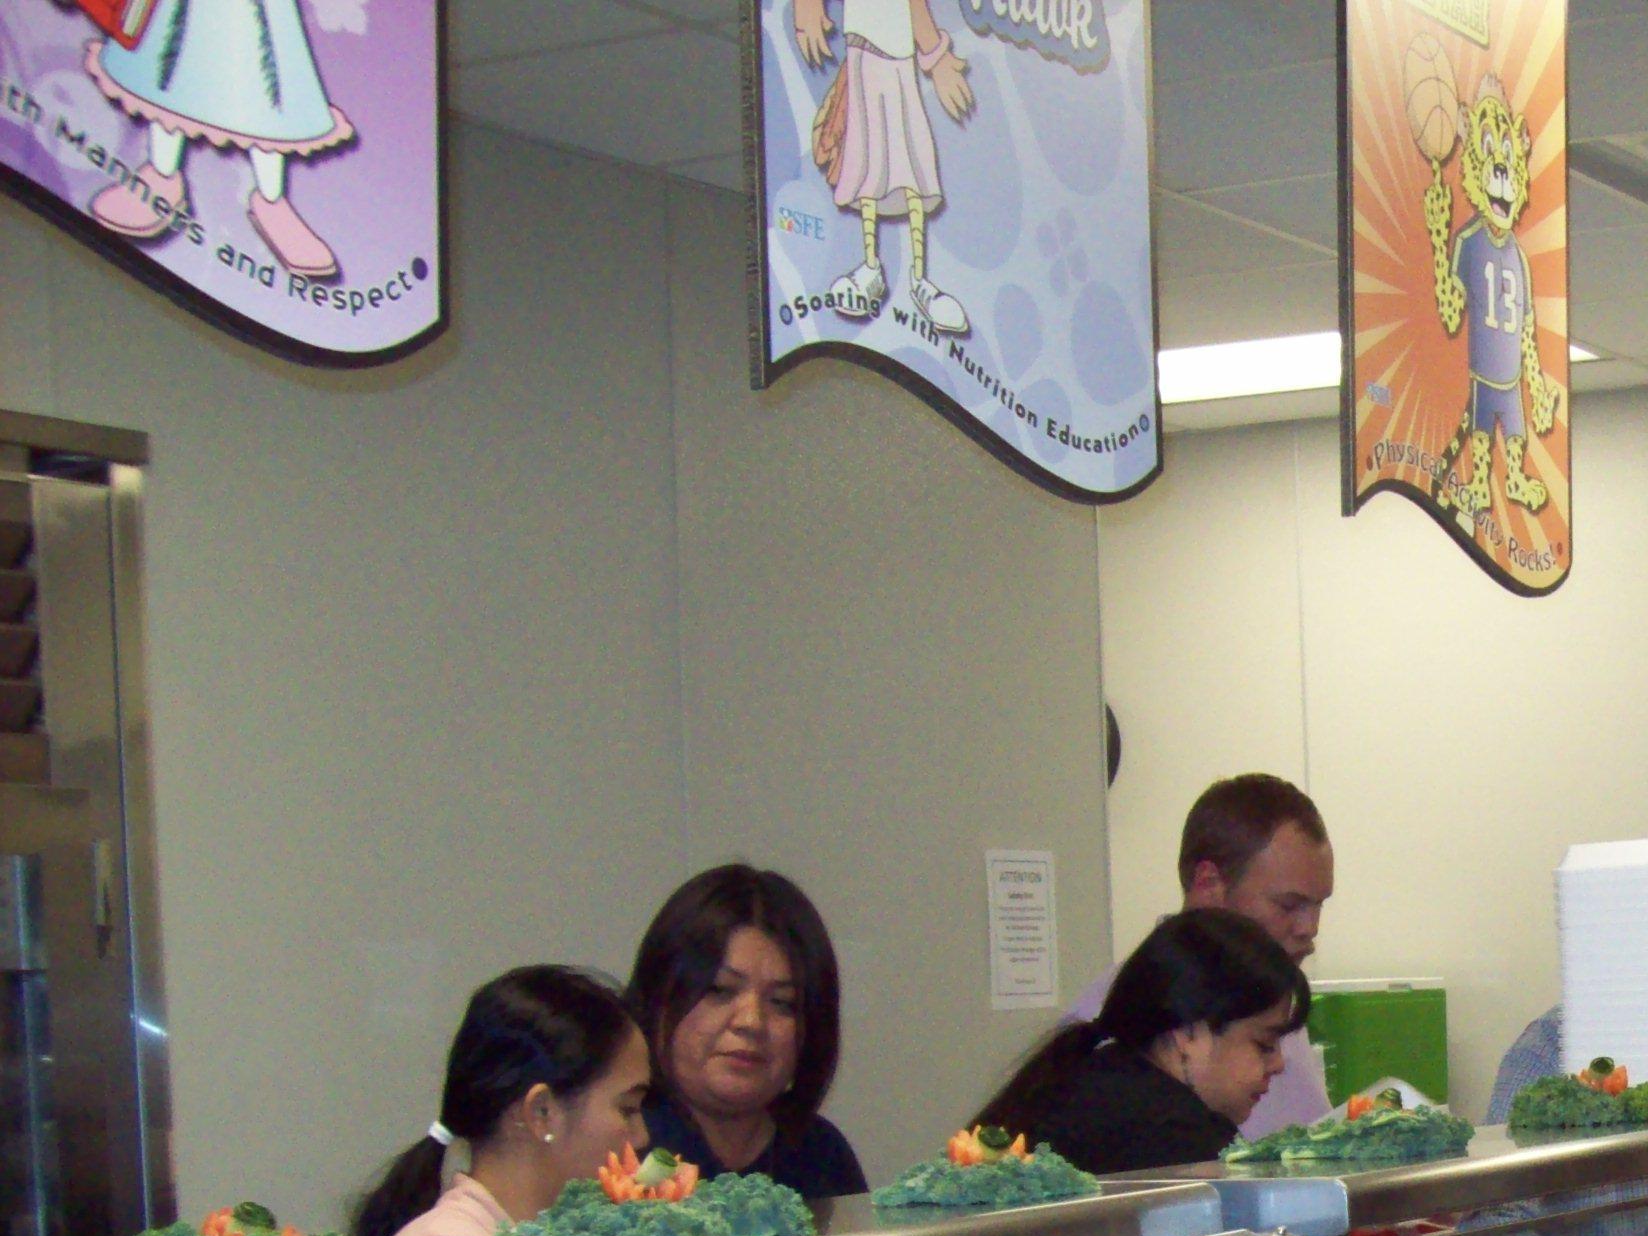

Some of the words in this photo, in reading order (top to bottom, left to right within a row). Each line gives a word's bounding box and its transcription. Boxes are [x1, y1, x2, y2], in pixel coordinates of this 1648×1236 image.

[56, 117, 206, 246] Manners
[217, 244, 276, 287] and
[288, 270, 413, 316] Respect
[794, 288, 881, 319] Soaring
[893, 307, 939, 347] with
[949, 340, 1038, 428] Nutrition
[1046, 417, 1139, 453] Education
[1484, 261, 1517, 334] 13
[1373, 439, 1444, 480] Physical
[1507, 537, 1556, 572] Rocks!
